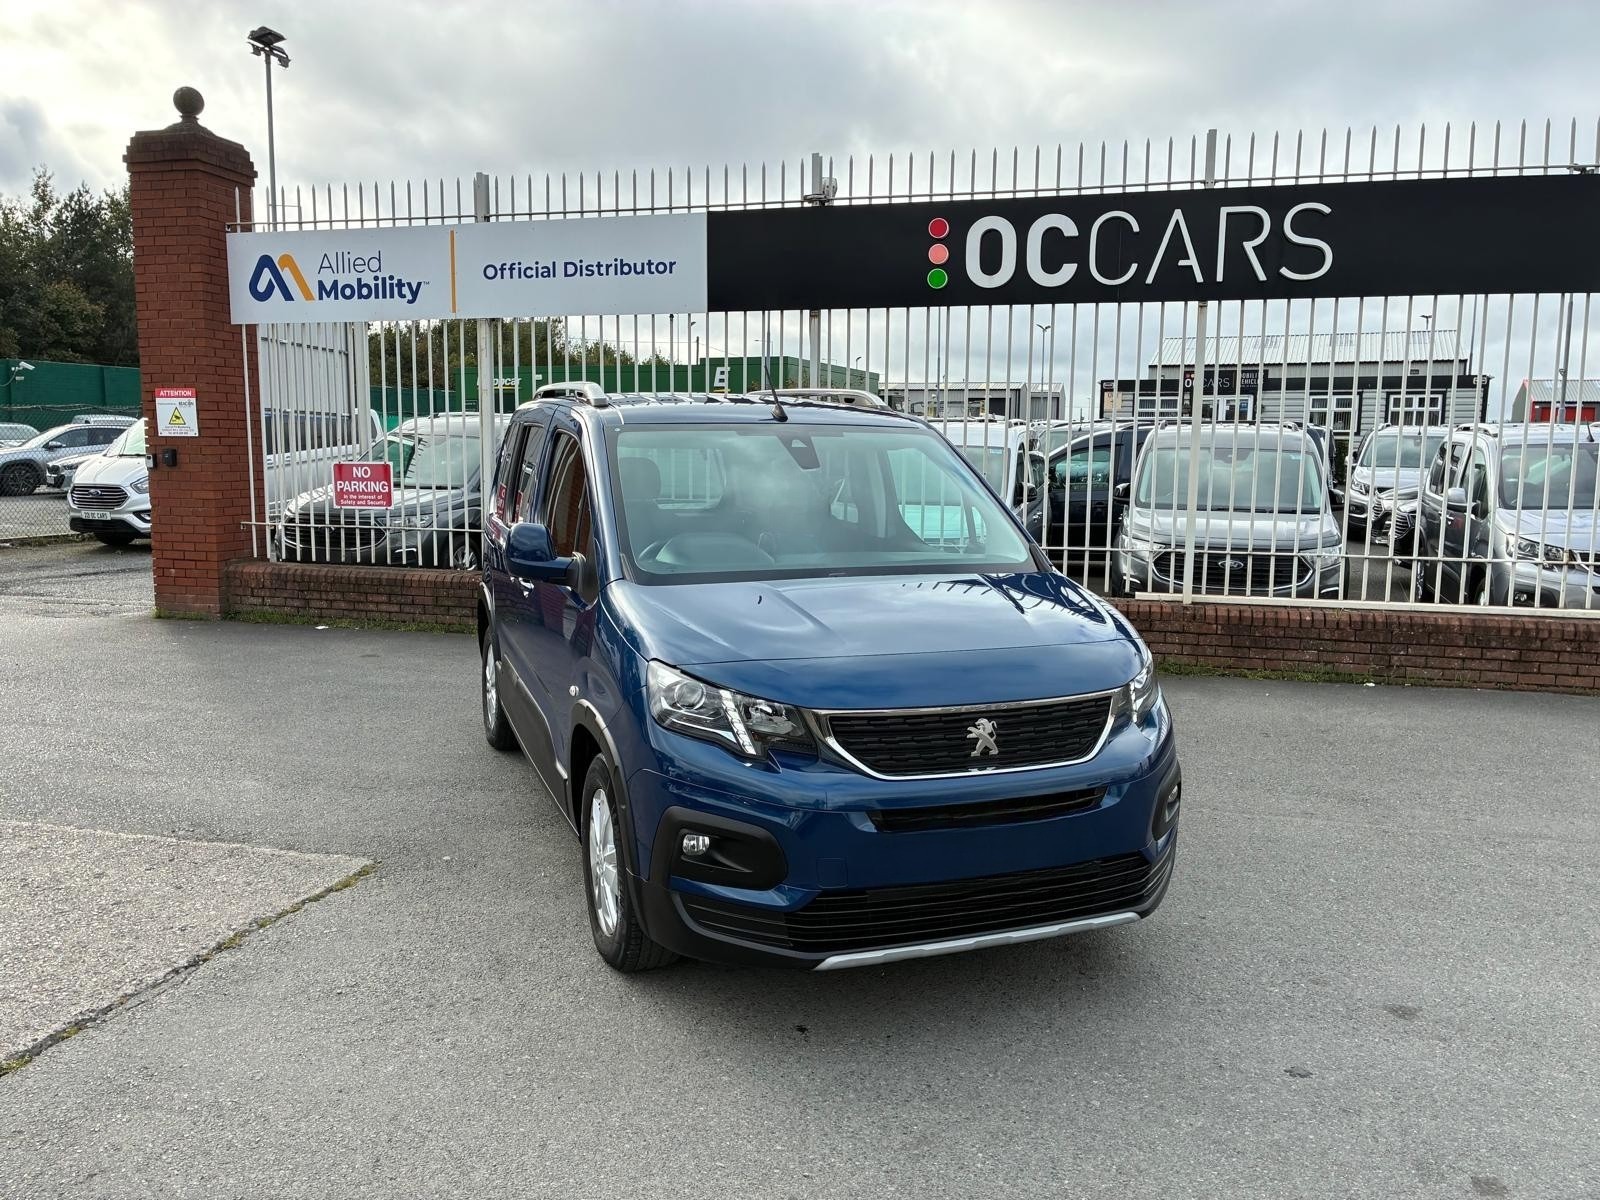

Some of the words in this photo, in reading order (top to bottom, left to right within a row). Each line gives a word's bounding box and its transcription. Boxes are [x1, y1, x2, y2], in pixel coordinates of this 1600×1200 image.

[317, 250, 382, 275] Allied
[483, 260, 556, 280] Official
[563, 257, 677, 278] Distributor
[317, 275, 423, 304] Mobility
[1184, 378, 1230, 388] OCARS
[352, 466, 371, 478] NO
[336, 480, 388, 492] PARKING
